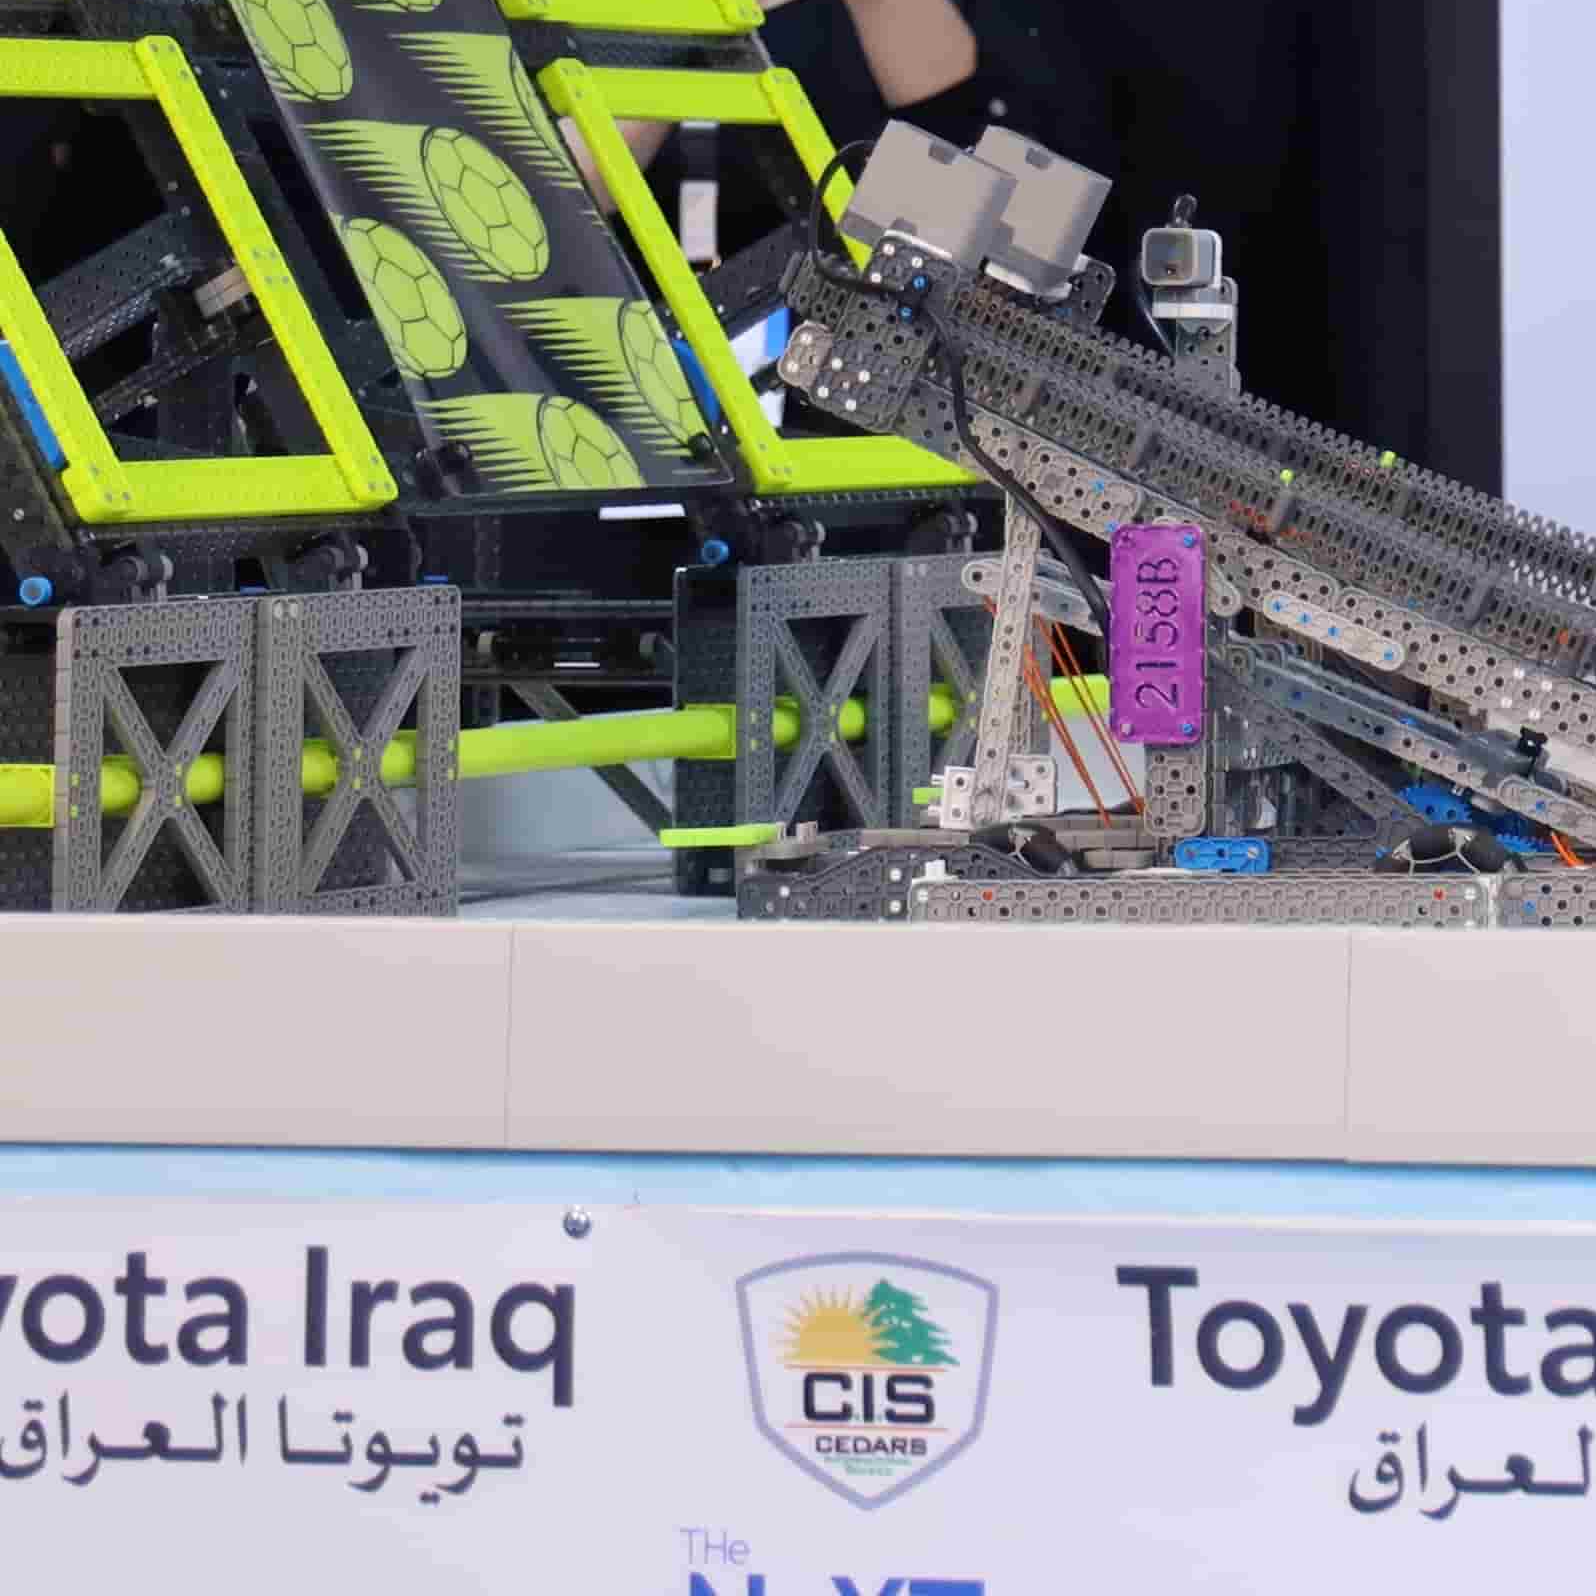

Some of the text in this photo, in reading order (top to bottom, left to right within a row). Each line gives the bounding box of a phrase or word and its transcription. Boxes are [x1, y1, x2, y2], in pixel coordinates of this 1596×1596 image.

[1133, 556, 1182, 710] 2158B
[303, 1245, 577, 1408] Iraq
[0, 1389, 526, 1506] تويوتا العراق
[802, 1371, 938, 1426] CIS
[813, 1434, 930, 1459] CEDARS
